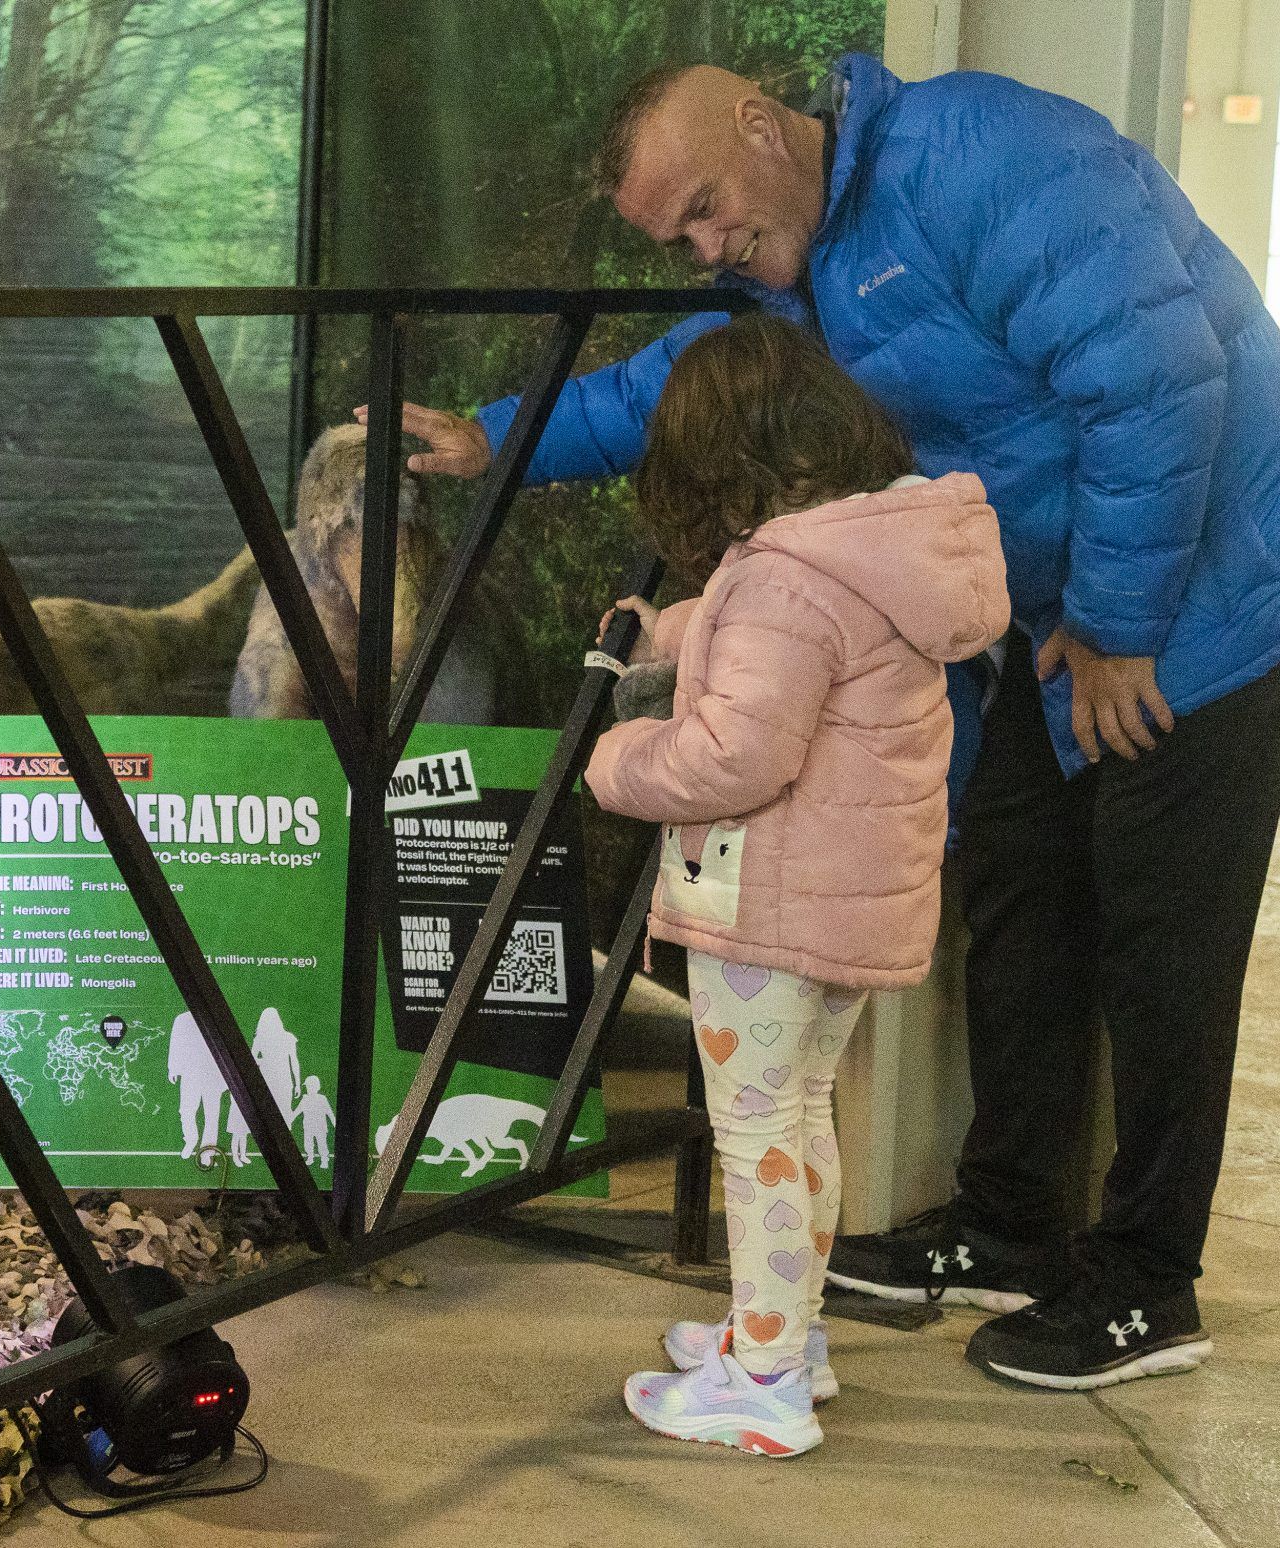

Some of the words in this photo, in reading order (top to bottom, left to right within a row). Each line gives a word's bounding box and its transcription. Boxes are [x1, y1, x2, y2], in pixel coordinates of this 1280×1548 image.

[393, 818, 420, 836] DID
[422, 818, 452, 838] YOU
[453, 820, 508, 839] KNOW?
[396, 839, 469, 851] Protoceratops
[470, 841, 479, 850] is
[480, 842, 497, 851] 1/2
[499, 842, 510, 851] of
[396, 850, 424, 860] fossil
[425, 851, 448, 862] find,
[449, 852, 467, 861] the
[468, 853, 508, 865] Fighting
[397, 863, 405, 871] It
[406, 864, 427, 872] was
[429, 863, 463, 873] locked
[464, 865, 474, 873] in
[13, 876, 74, 891] MEANING:
[81, 882, 108, 892] First
[405, 875, 469, 886] velociraptor.
[13, 906, 70, 915] Herbivore
[400, 916, 434, 931] WANT
[435, 917, 450, 932] TO
[13, 930, 21, 939] 2
[24, 930, 65, 939] meters
[67, 929, 91, 941] (6.6
[93, 929, 117, 939] feet
[120, 929, 150, 942] long)
[401, 931, 451, 951] KNOW
[15, 948, 27, 964] IT
[29, 948, 68, 964] LIVED:
[75, 954, 101, 964] Late
[103, 954, 165, 964] Cretaceou
[215, 954, 255, 964] million
[257, 956, 288, 967] years
[291, 955, 317, 968] ago)
[402, 950, 454, 971] MORE?
[20, 972, 33, 988] IT
[34, 972, 74, 988] LIVED:
[81, 978, 136, 989] Mongolia
[404, 977, 424, 988] SCAN
[425, 978, 439, 988] FOR
[404, 987, 425, 997] MORE
[426, 988, 445, 998] INFO!
